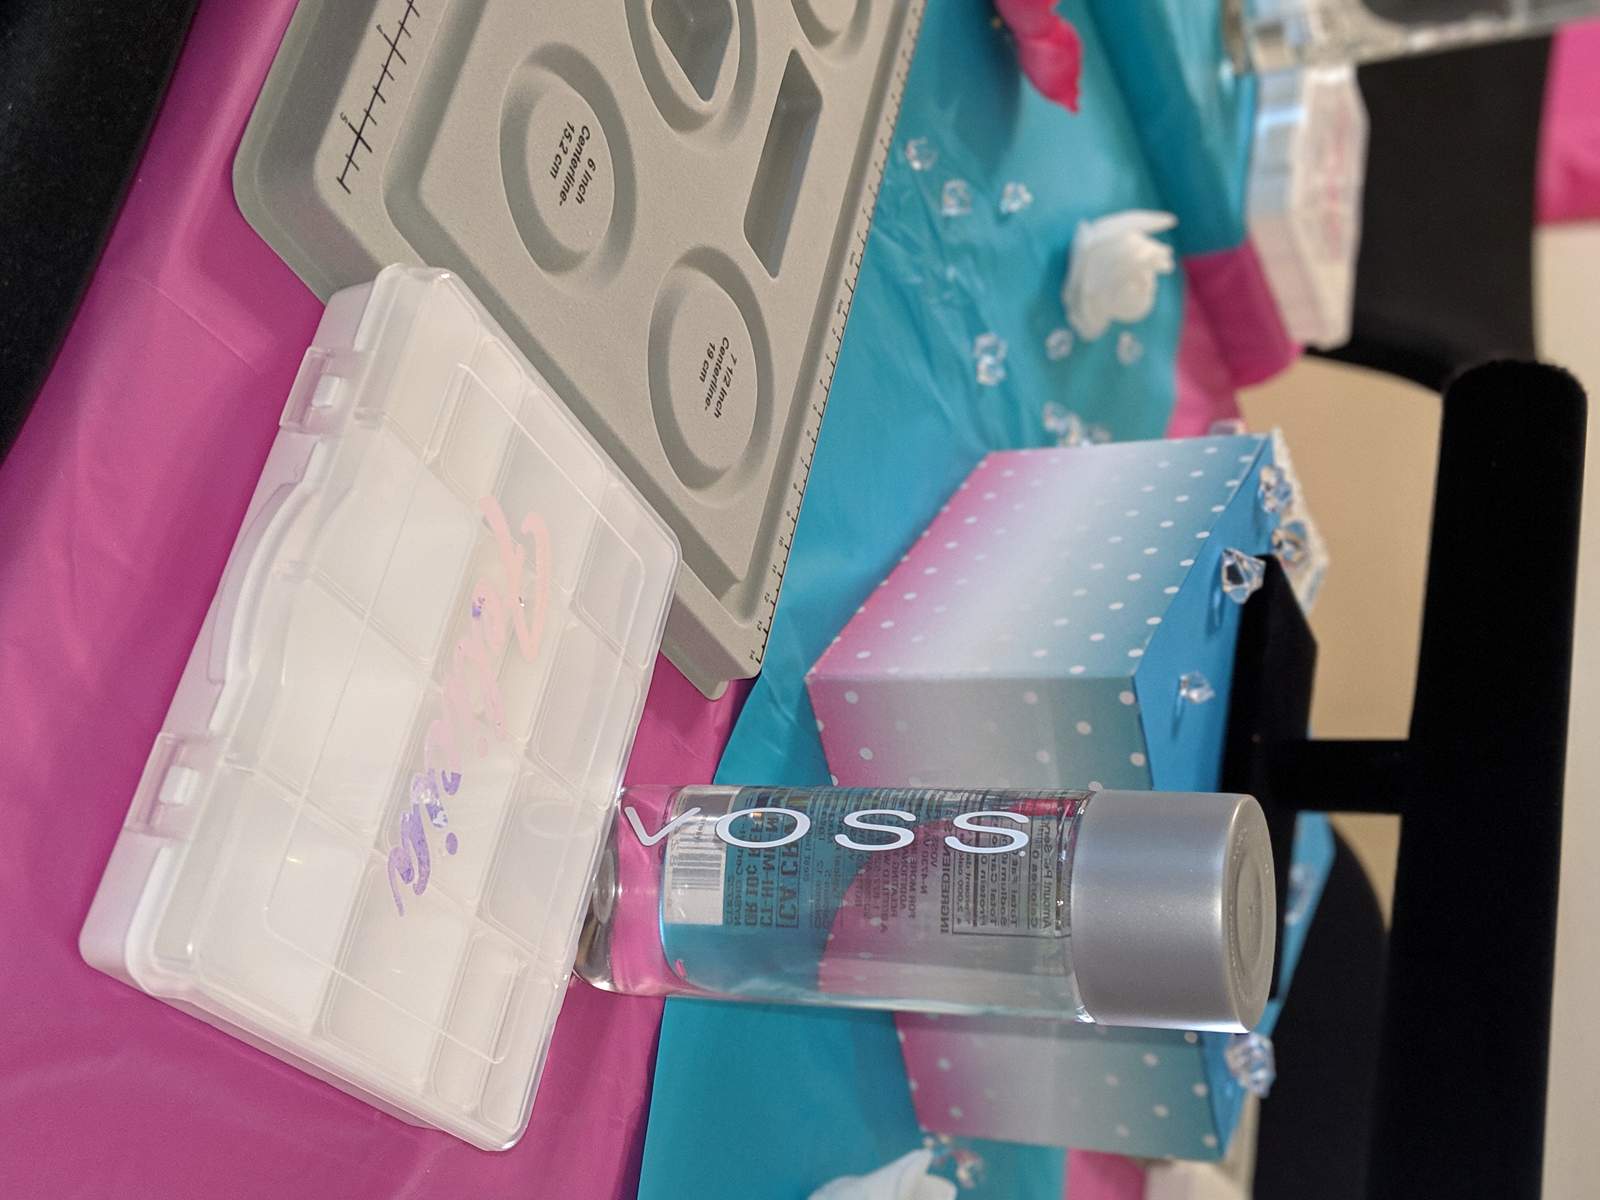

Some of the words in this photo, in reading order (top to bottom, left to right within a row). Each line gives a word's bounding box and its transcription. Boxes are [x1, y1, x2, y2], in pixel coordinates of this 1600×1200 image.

[559, 121, 576, 156] 15.2
[550, 153, 562, 180] cm
[559, 125, 591, 206] Centerline-
[587, 158, 597, 173] 6
[575, 169, 593, 205] Inch
[706, 342, 716, 360] 19
[731, 353, 738, 366] 7
[699, 359, 709, 383] cm
[704, 337, 730, 412] Centerline-
[723, 366, 733, 388] 1/2
[714, 387, 728, 419] Inch
[624, 806, 1031, 854] VOSS
